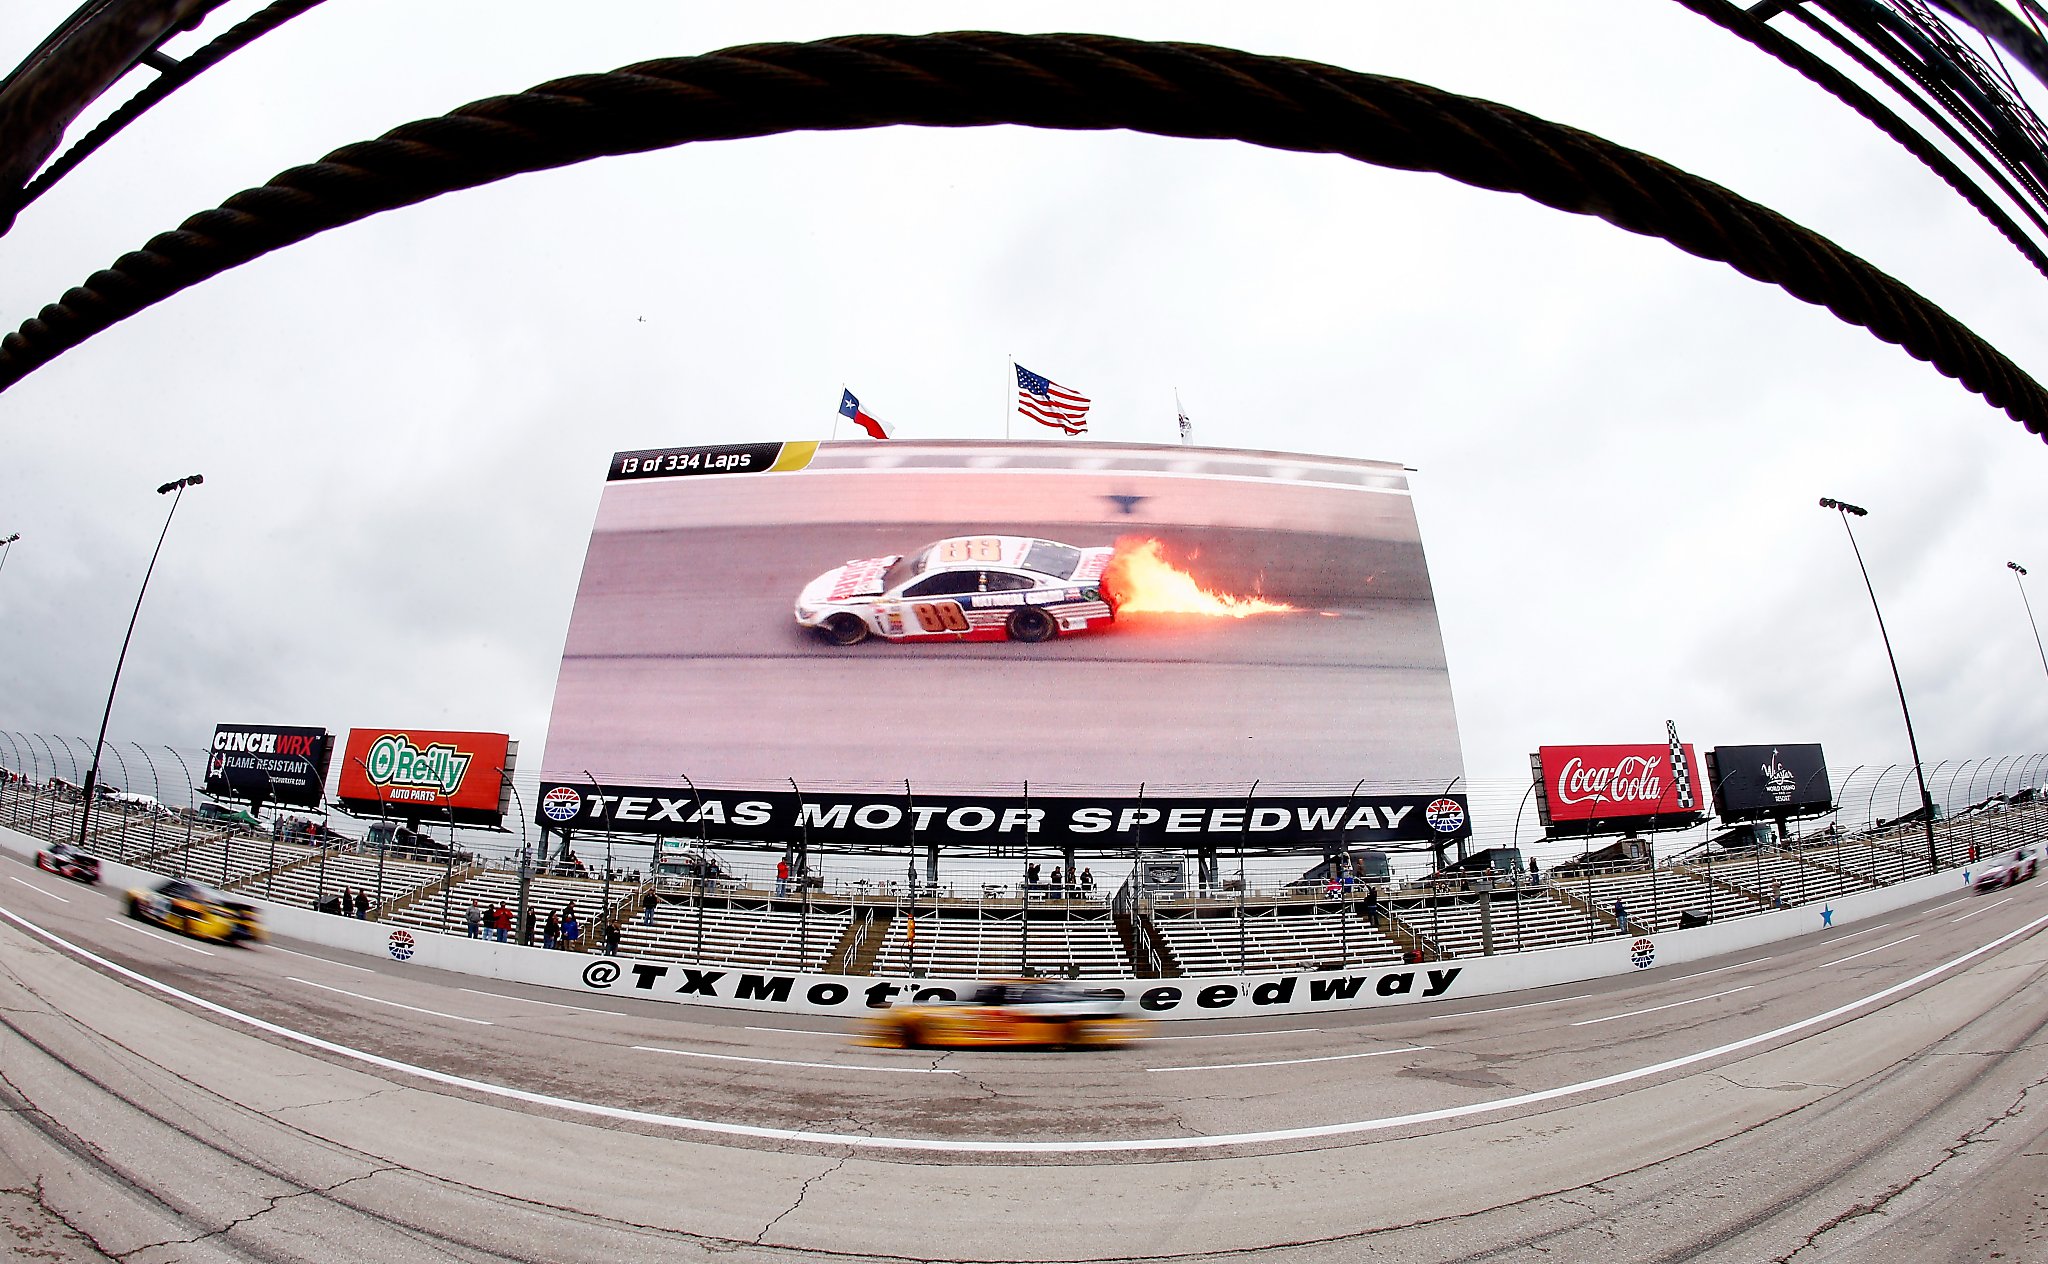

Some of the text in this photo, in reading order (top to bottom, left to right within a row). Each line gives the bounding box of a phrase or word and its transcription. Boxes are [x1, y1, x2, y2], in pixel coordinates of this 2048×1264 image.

[621, 453, 751, 473] 13 of 334 Laps
[912, 602, 970, 632] 88
[226, 756, 309, 774] FLAME RESISTANT
[369, 739, 467, 791] O'Reilly
[1558, 756, 1661, 804] Coca-Cola
[389, 788, 436, 801] AUTO PARTS
[586, 795, 1414, 833] TEXAS MOTOR SPEEDWAY
[582, 960, 1463, 1012] @TXMotoeedway
